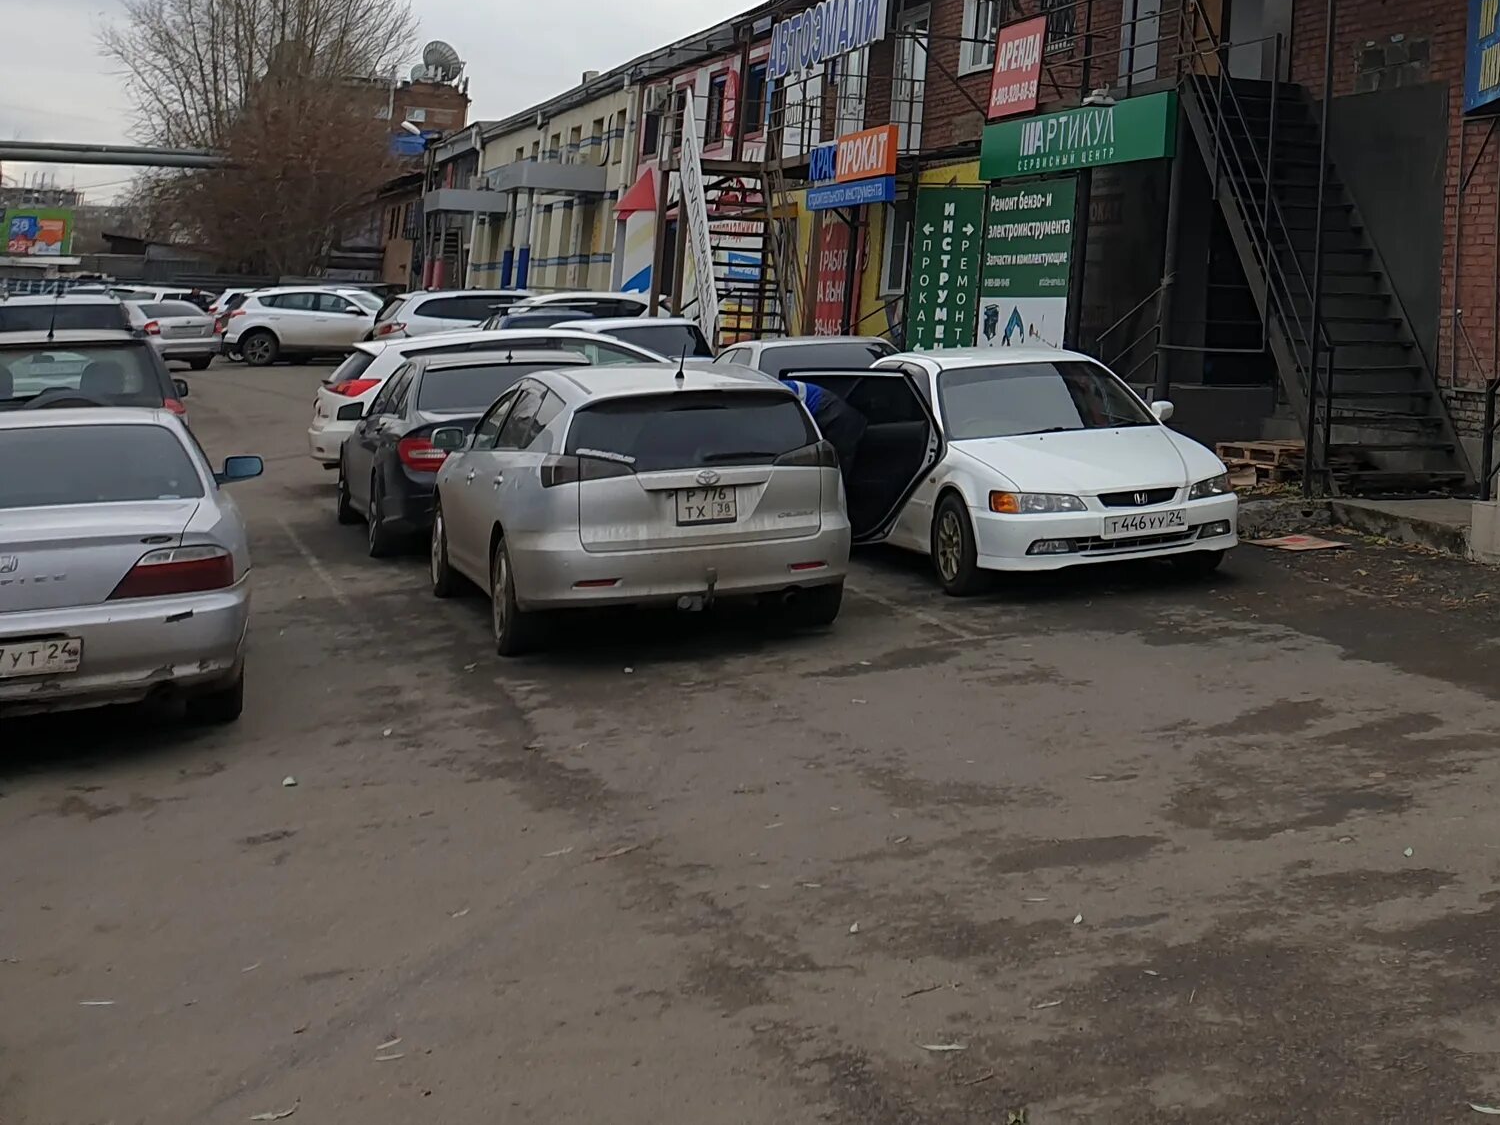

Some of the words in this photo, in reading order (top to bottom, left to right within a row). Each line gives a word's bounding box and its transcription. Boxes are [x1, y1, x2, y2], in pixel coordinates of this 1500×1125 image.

[997, 33, 1041, 73] АРЕНДА
[1033, 107, 1115, 155] АРТИКУЛ
[838, 132, 888, 175] ПРОКАТ
[1018, 151, 1076, 172] СЕРВИСНЫЙ
[1081, 147, 1115, 164] ЦЕНТР
[990, 195, 1018, 212] Ремонт
[1018, 191, 1045, 210] бензо-
[988, 219, 1071, 241] электроинструмента
[986, 252, 1011, 266] Запчасти
[1017, 251, 1068, 267] комплектующие
[917, 239, 932, 339] ПРОКАТ
[954, 240, 970, 340] РЕМОНТ
[1169, 511, 1182, 523] 24
